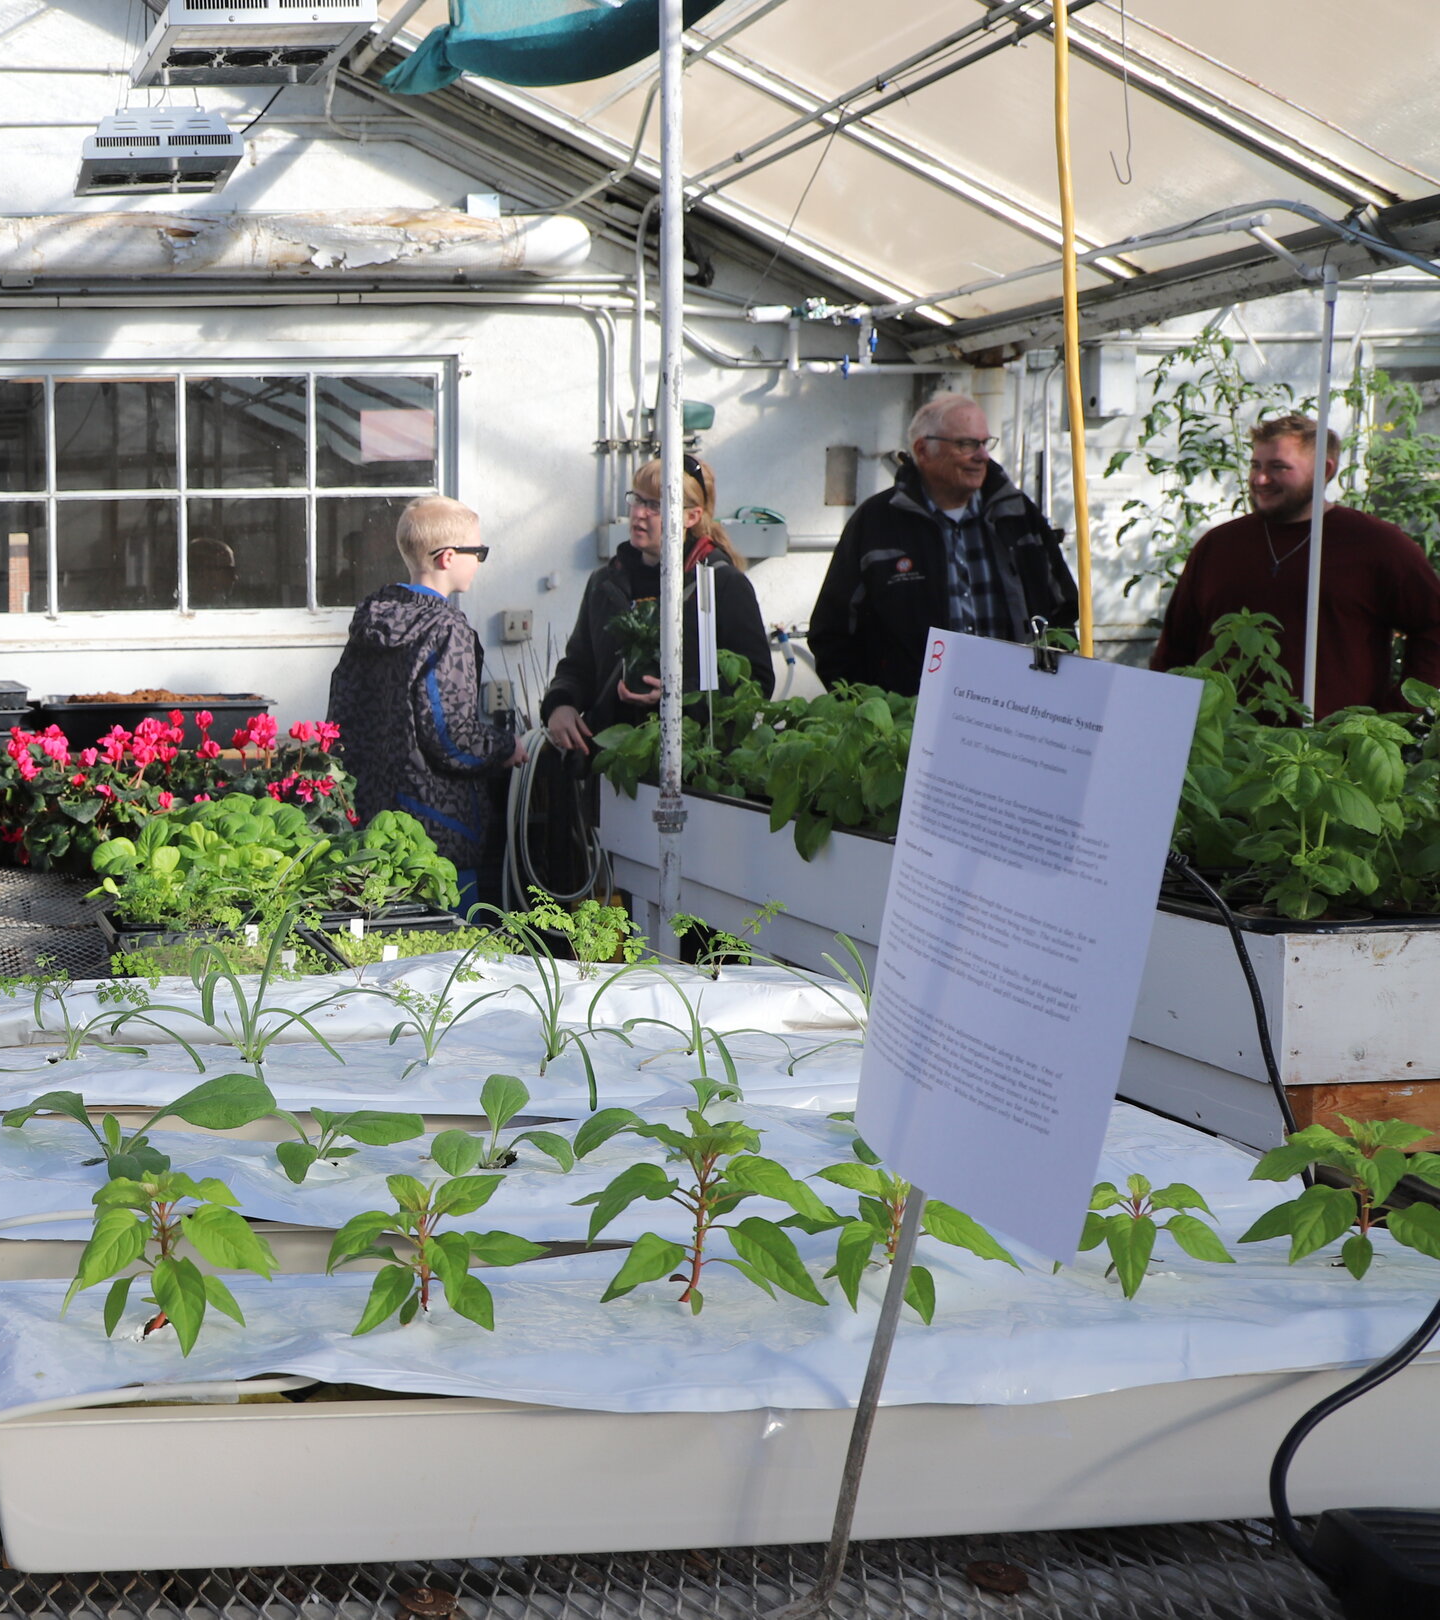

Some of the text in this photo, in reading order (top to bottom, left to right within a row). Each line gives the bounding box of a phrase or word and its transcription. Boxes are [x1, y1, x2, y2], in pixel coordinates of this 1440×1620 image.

[927, 639, 946, 673] B
[953, 686, 965, 697] Cut
[965, 689, 991, 704] Flowers
[1006, 699, 1030, 714] Closed
[1030, 705, 1073, 725] Hydroponic
[1074, 716, 1104, 733] System
